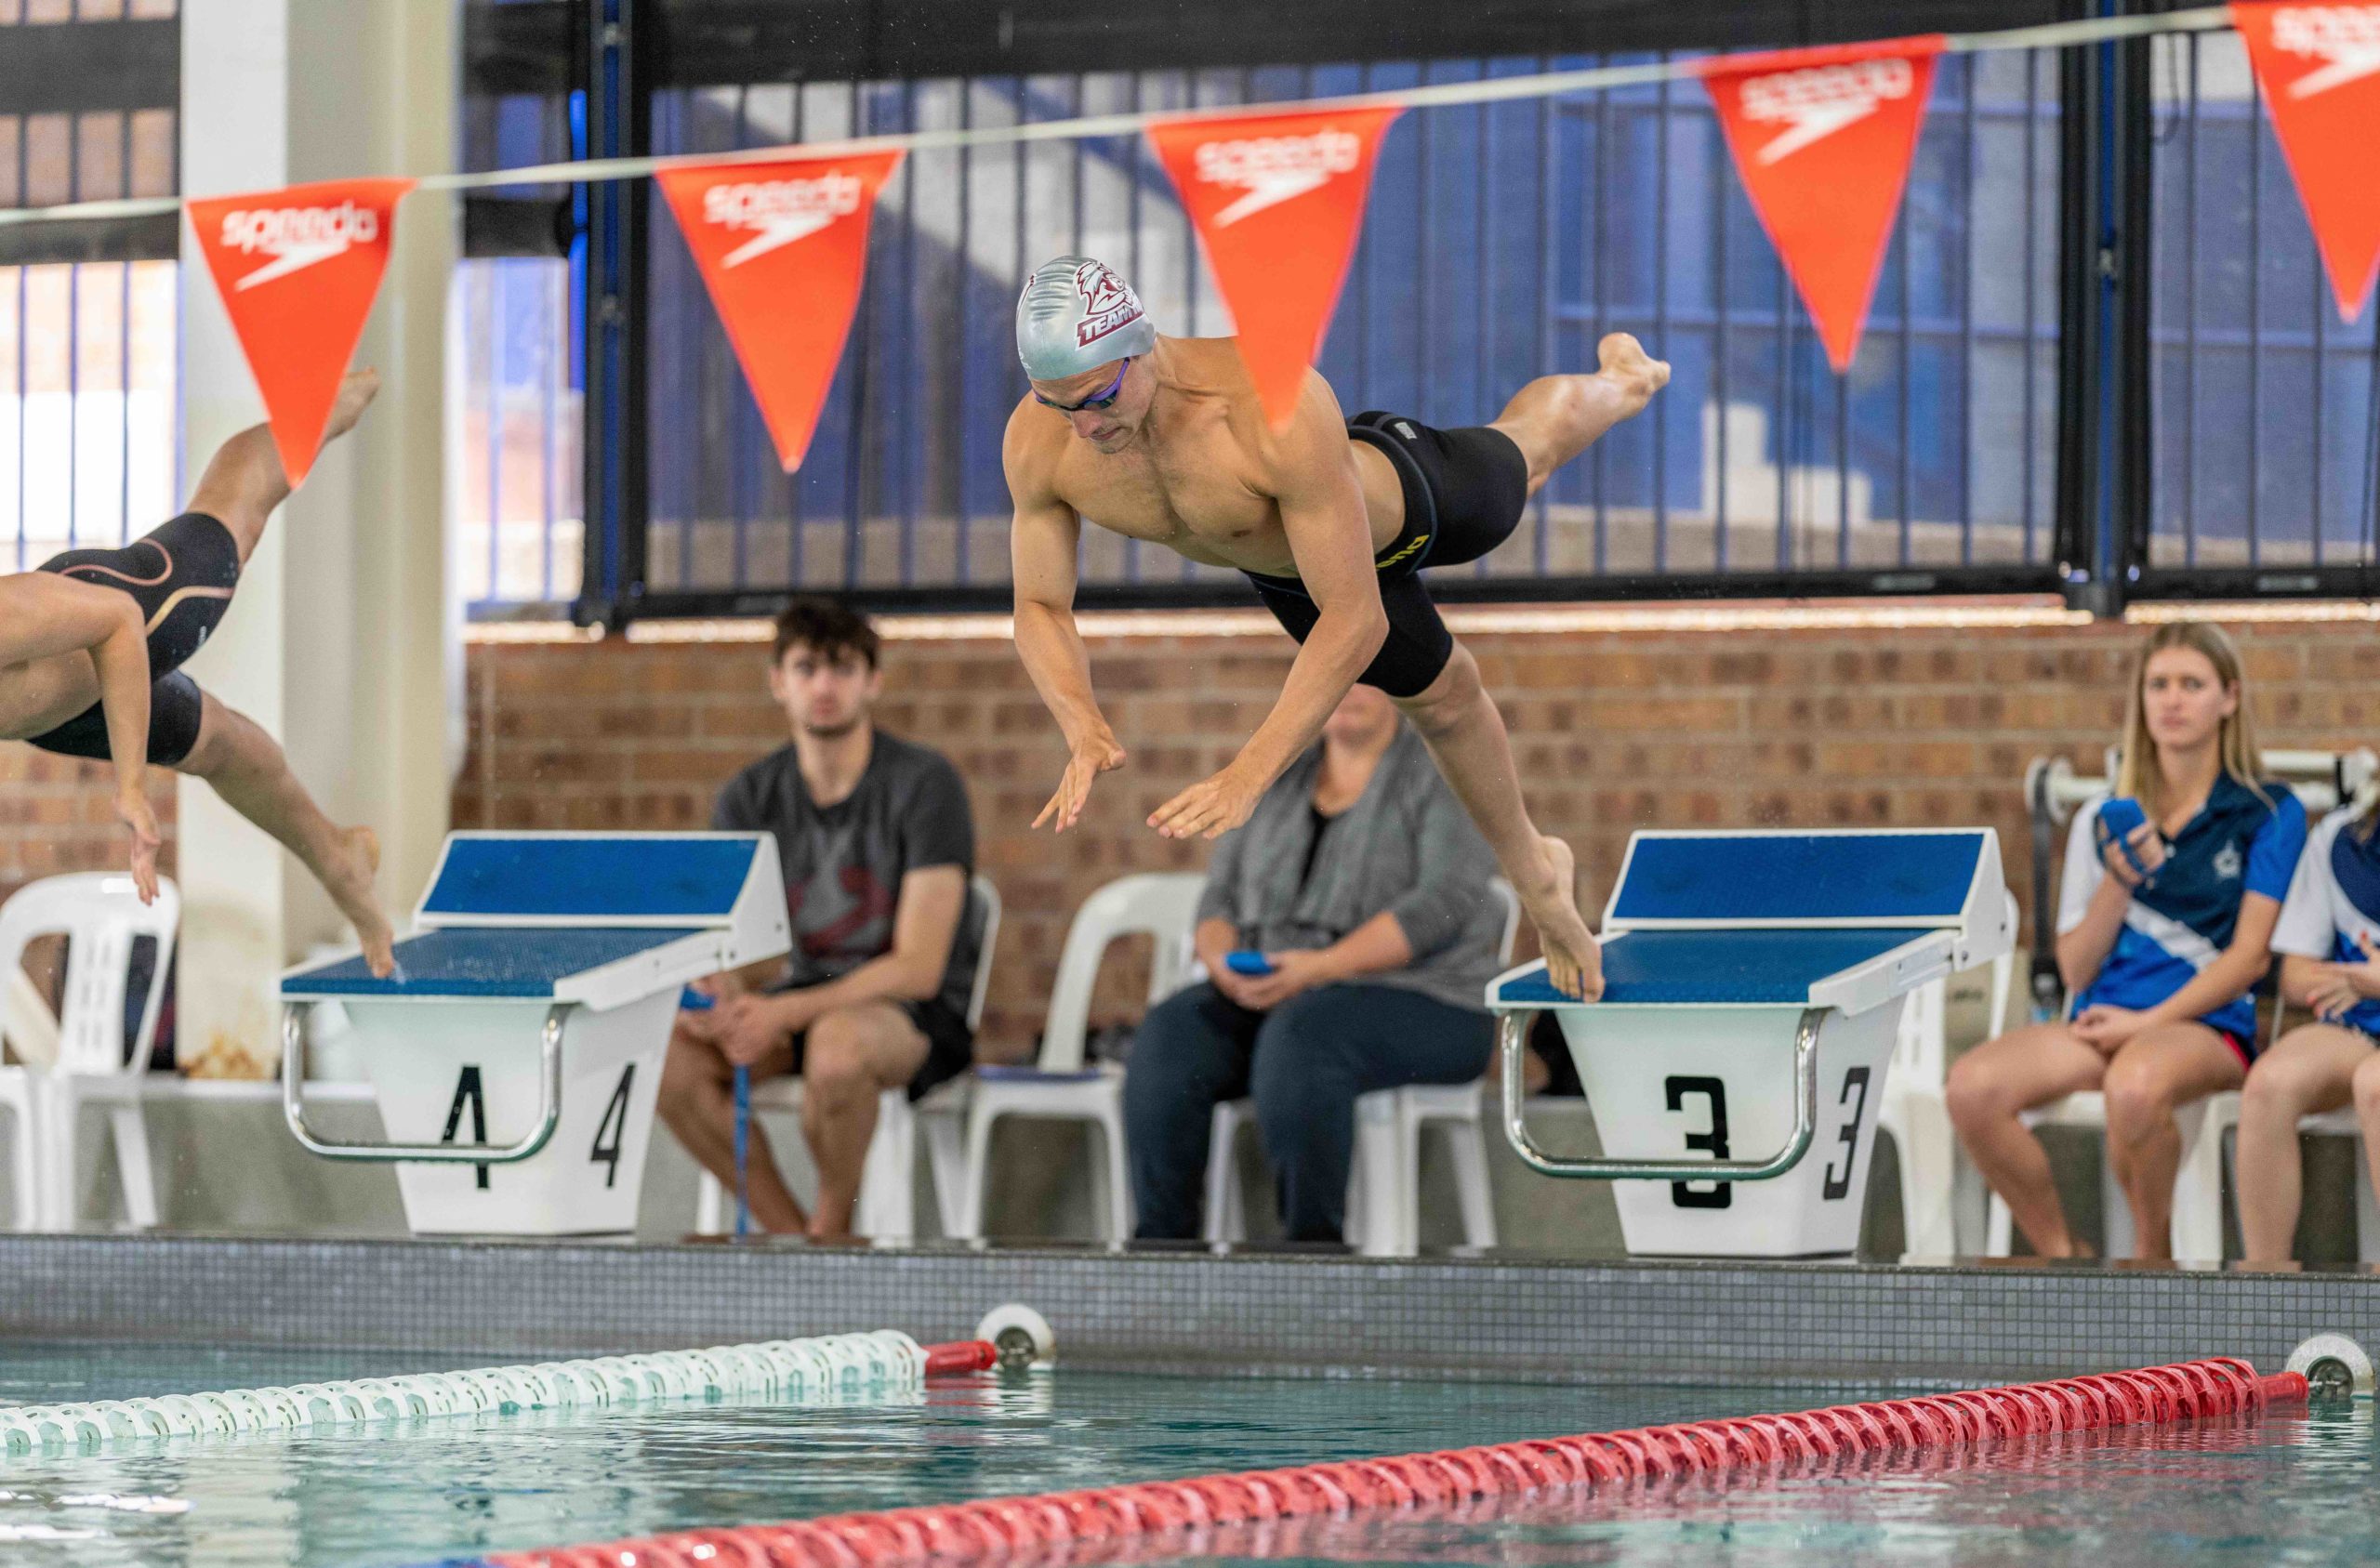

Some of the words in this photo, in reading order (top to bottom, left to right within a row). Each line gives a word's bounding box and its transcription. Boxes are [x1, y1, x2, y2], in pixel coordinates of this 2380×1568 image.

[1739, 58, 1913, 127] speedo
[1196, 125, 1360, 190] speedo
[220, 199, 378, 256] speedo
[704, 167, 862, 231] speedo
[1082, 307, 1132, 341] TEAM
[443, 1066, 489, 1189] 4
[591, 1064, 636, 1188] 4
[1665, 1076, 1732, 1208] 3
[1823, 1067, 1871, 1200] 3
